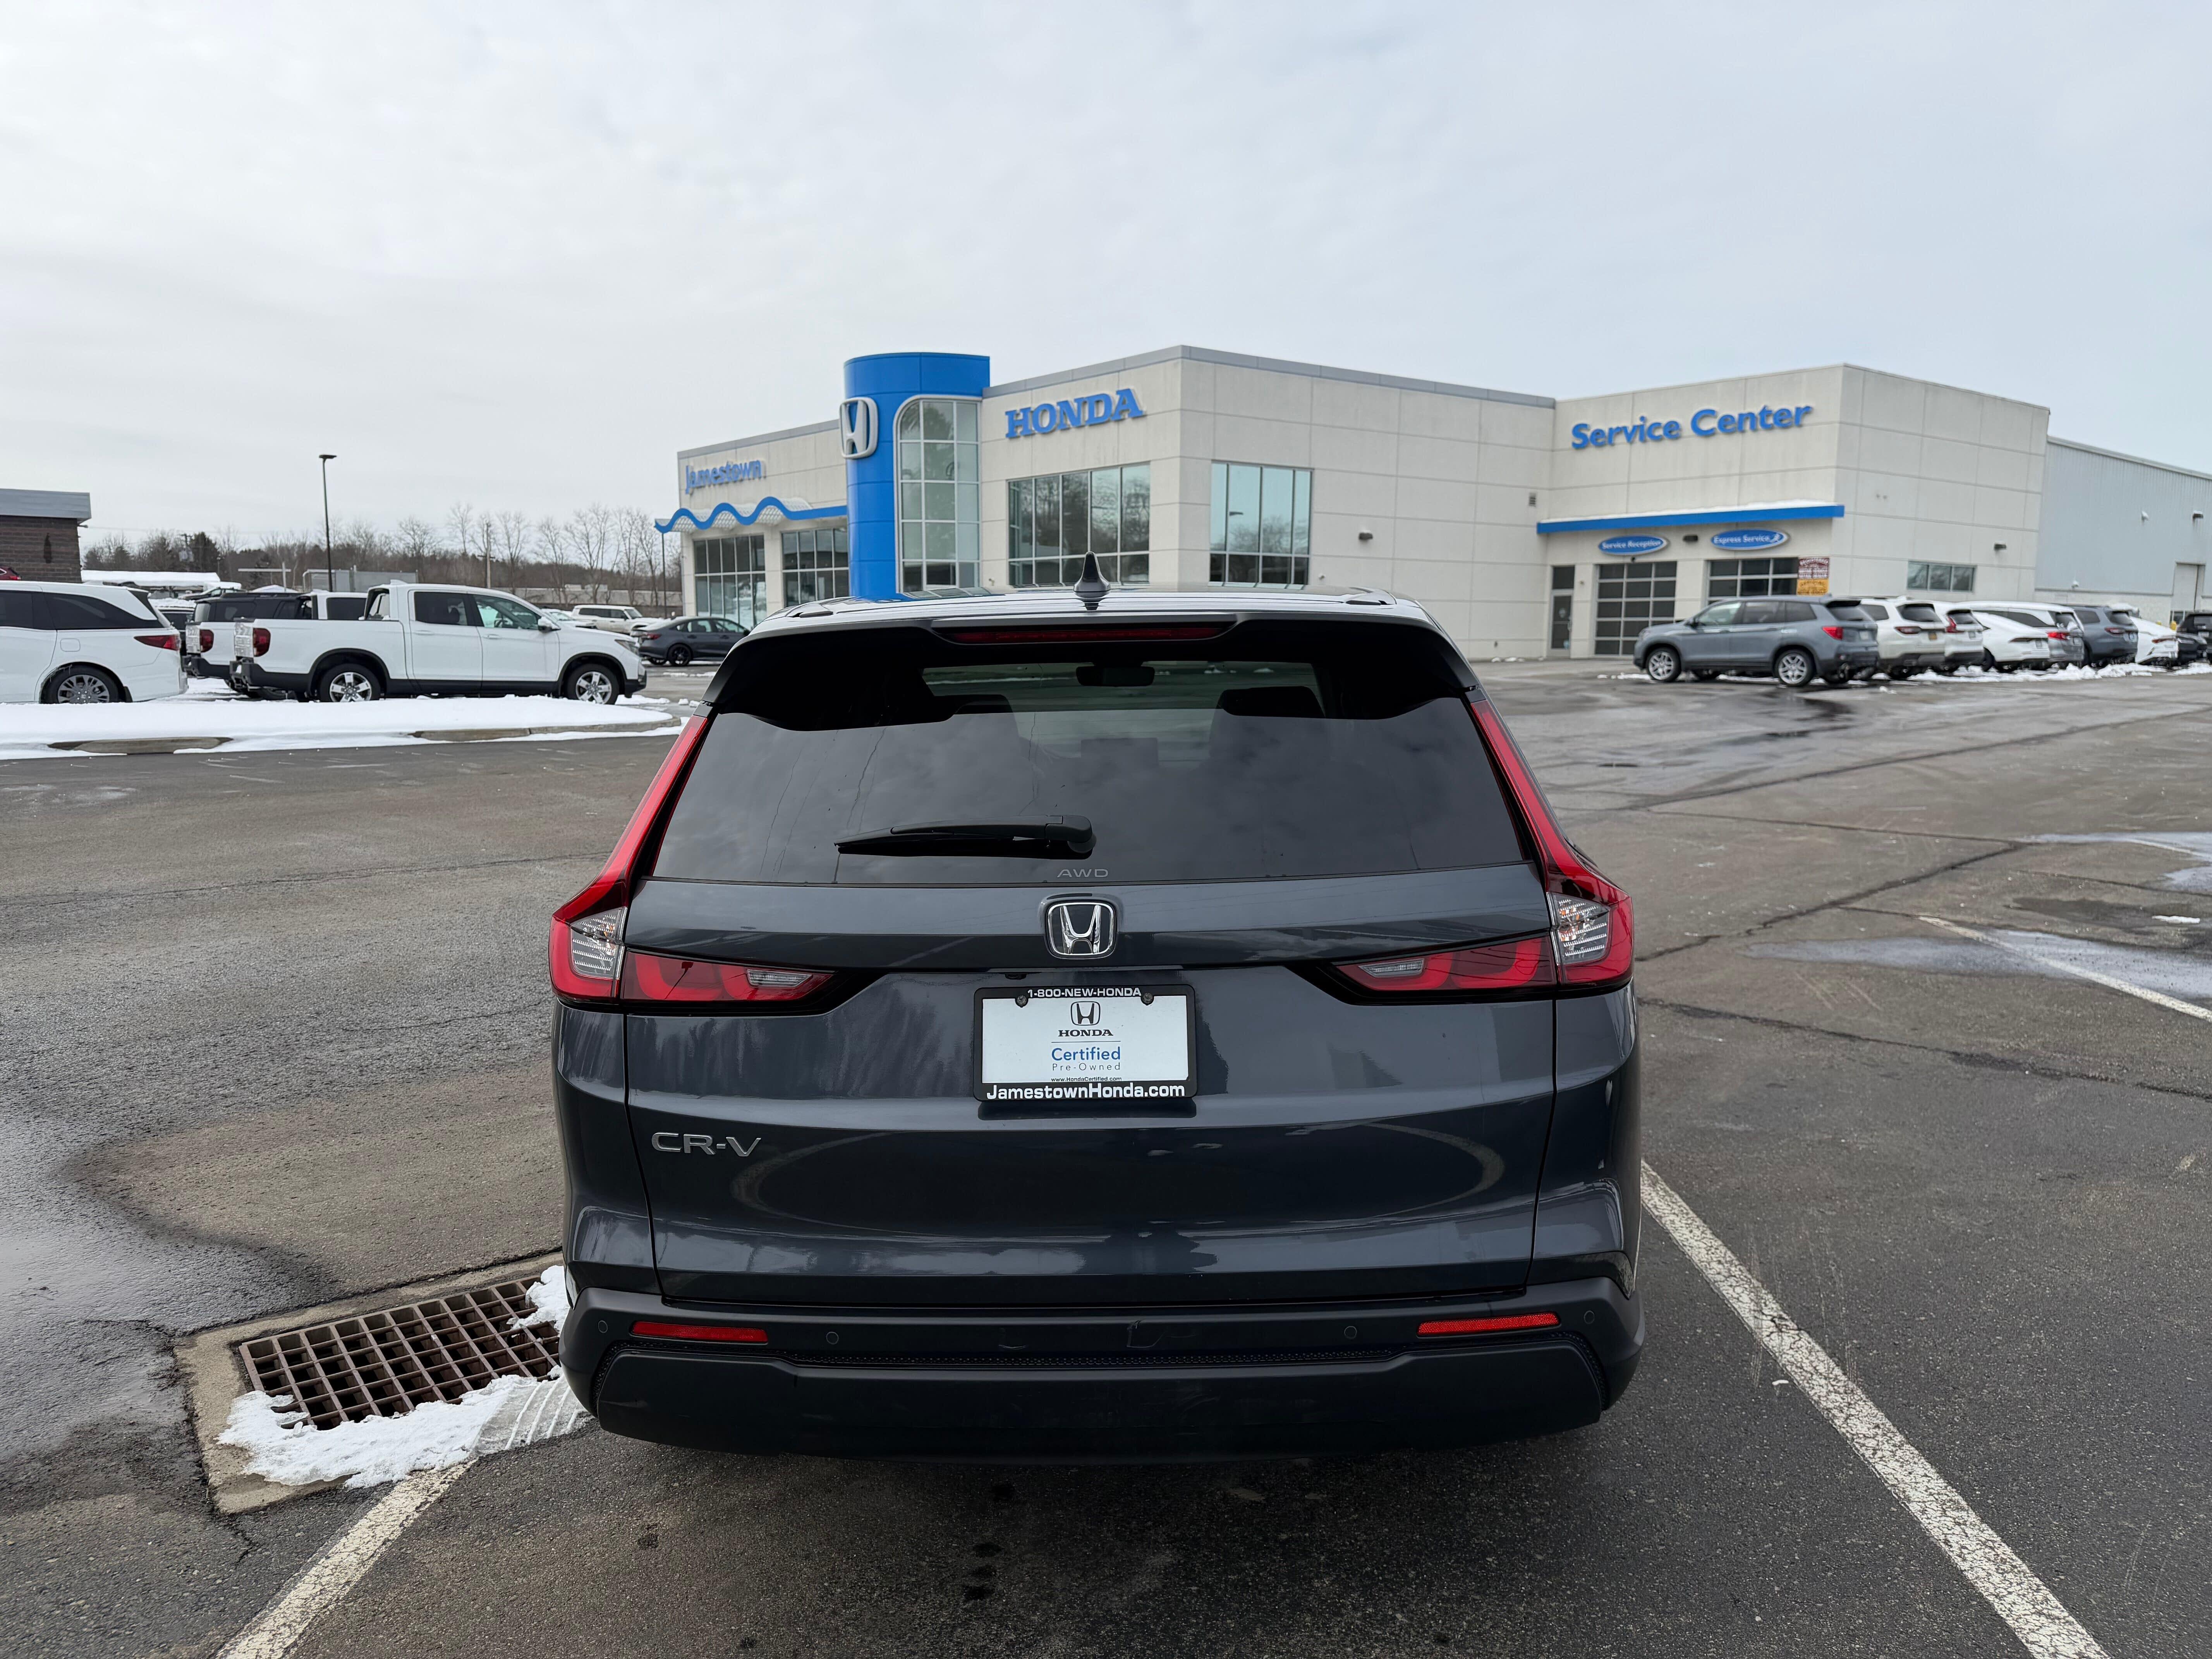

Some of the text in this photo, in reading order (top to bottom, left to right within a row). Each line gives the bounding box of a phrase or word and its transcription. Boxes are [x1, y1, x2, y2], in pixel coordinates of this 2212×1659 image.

[1005, 388, 1143, 438] HONDA
[1571, 405, 1813, 449] Service Center
[685, 460, 761, 494] Jamestown
[1628, 540, 1661, 548] Reception
[1713, 534, 1770, 545] Express Service
[1057, 869, 1108, 878] AWD
[1028, 988, 1142, 998] 1-800-NEW-HONDA
[1051, 1046, 1120, 1061] Certified
[1053, 1062, 1120, 1071] Pre-Owned
[987, 1083, 1185, 1099] JamestownHonda.com
[651, 1132, 761, 1157] CR-V
